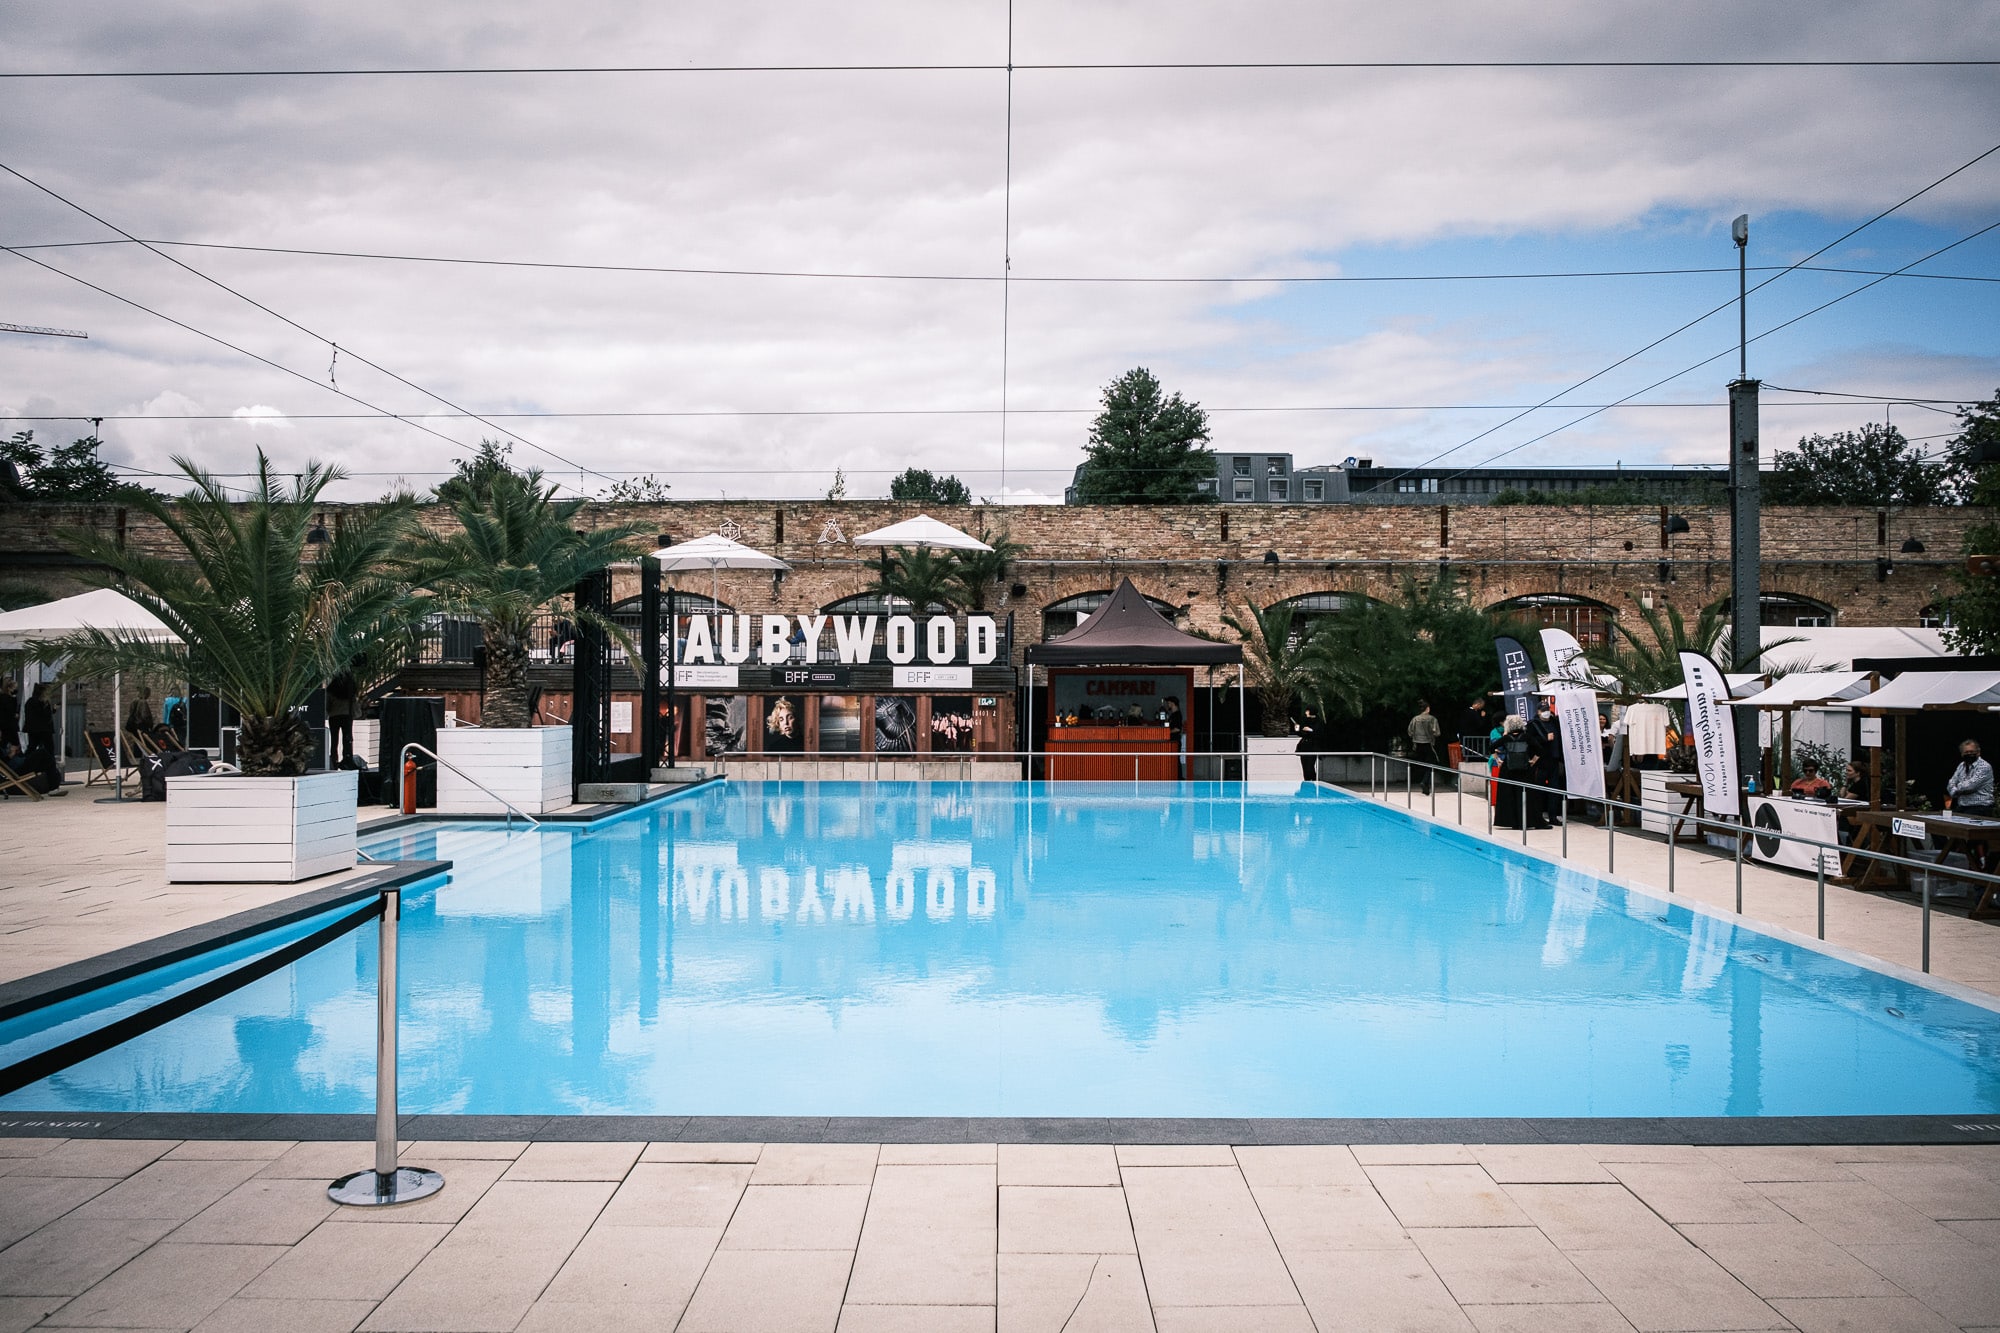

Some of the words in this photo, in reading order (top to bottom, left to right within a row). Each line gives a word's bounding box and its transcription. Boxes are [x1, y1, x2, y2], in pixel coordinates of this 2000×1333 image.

[675, 671, 693, 682] FF
[785, 671, 808, 683] BFF
[908, 671, 931, 683] BFF
[1086, 679, 1156, 696] CAMPARI
